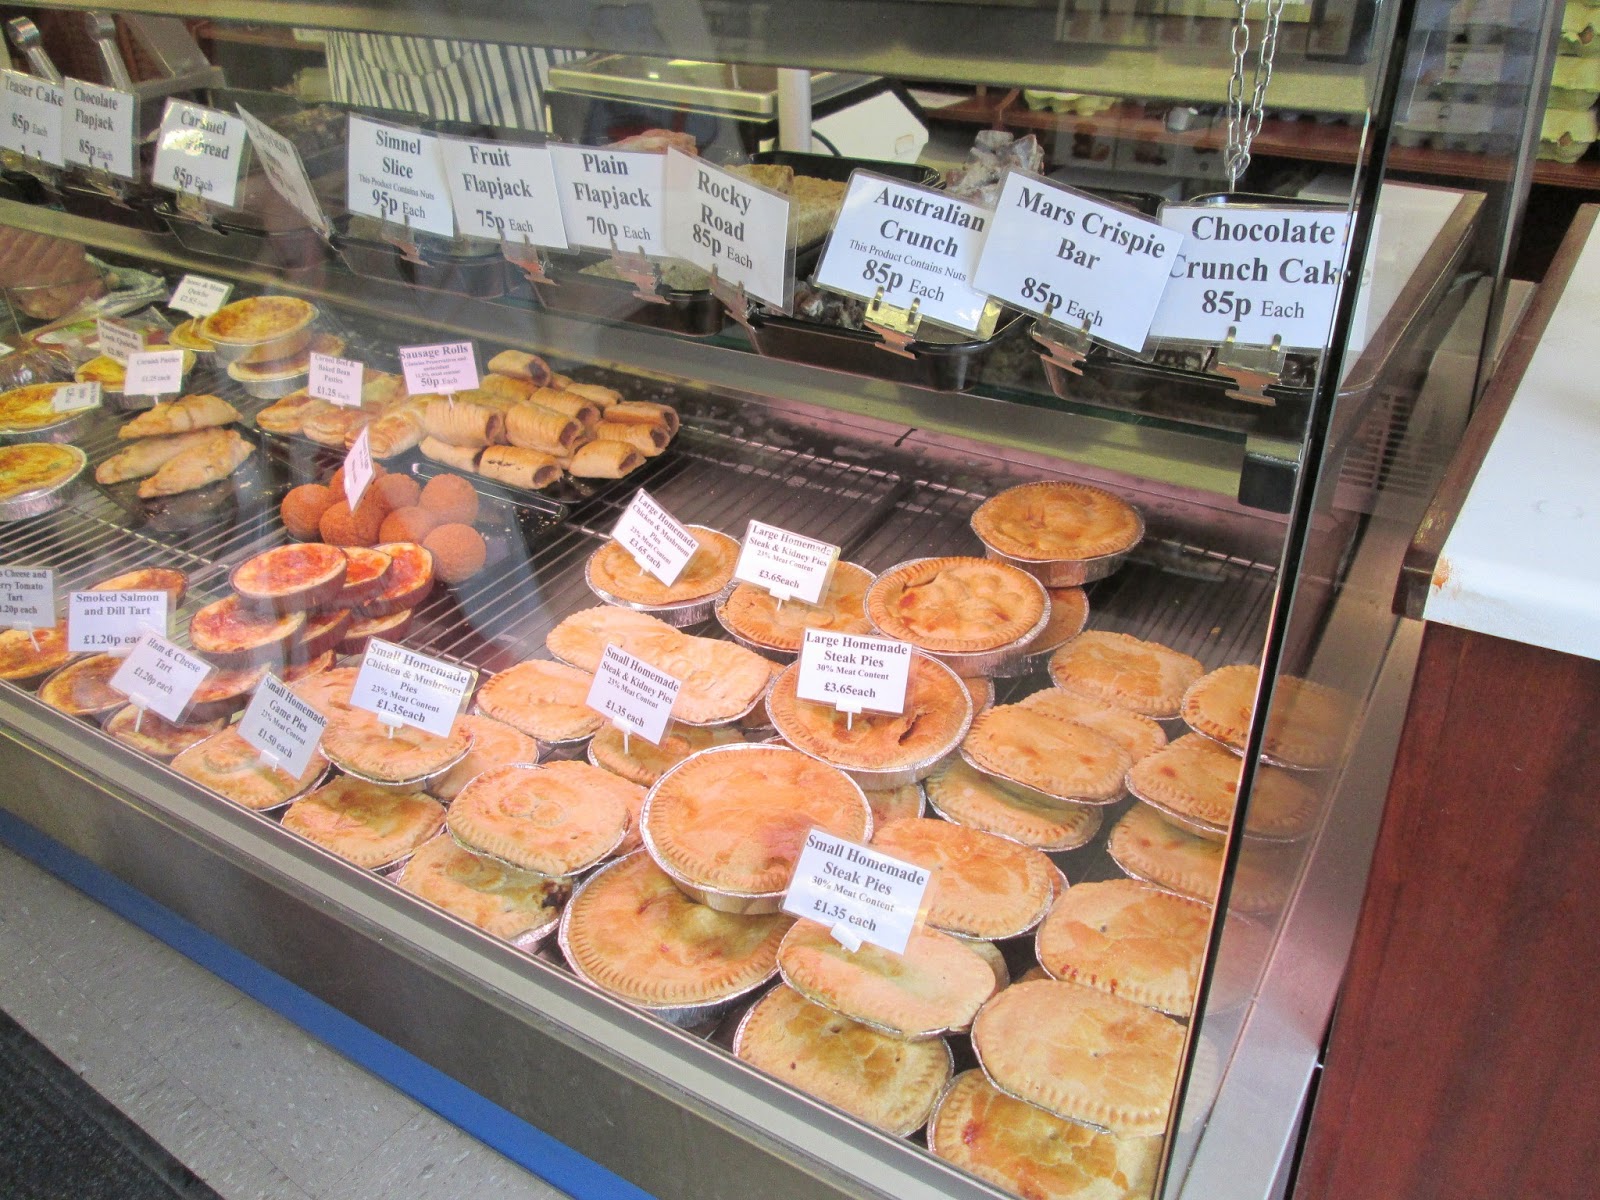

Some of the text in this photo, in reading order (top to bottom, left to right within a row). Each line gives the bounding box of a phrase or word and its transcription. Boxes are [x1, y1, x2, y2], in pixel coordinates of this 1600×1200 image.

[36, 86, 64, 106] Cake
[75, 87, 117, 110] Chocolate
[12, 113, 29, 134] 85p
[76, 108, 113, 131] Flapjack
[79, 139, 95, 158] 85p
[376, 130, 421, 155] Simnel
[469, 146, 512, 167] Fruit
[382, 157, 413, 179] Slice
[582, 153, 629, 175] Plain
[173, 166, 213, 192] 85p Each
[359, 174, 435, 200] This Product Contains Nuts
[463, 173, 534, 200] Flapjack
[698, 170, 751, 216] Rocky
[372, 189, 426, 218] 95p Each
[573, 182, 652, 210] Flapjack
[874, 187, 985, 232] Australian
[476, 210, 534, 233] 75p Each
[586, 216, 651, 241] 70p Each
[701, 204, 745, 242] Road
[1016, 186, 1166, 258] Mars Crispie
[1192, 215, 1336, 244] Chocolate
[693, 224, 752, 269] 85p Each
[880, 219, 959, 257] Crunch
[849, 239, 966, 281] This Product Contains Nuts
[1056, 237, 1101, 270] Bar
[1170, 253, 1268, 282] Crunch
[862, 259, 944, 302] 85p Each
[1021, 277, 1103, 327] 85p Each
[1202, 290, 1304, 322] 85p Each
[400, 345, 468, 359] Sausage Rolls
[318, 386, 336, 397] £1.25
[325, 375, 343, 384] Pasties
[421, 377, 439, 387] 50p
[632, 505, 690, 558] Chicken & Mushroom
[637, 495, 696, 550] Large Homemade
[629, 525, 672, 565] 23% Meat Content
[649, 532, 661, 545] Pies
[748, 537, 827, 568] Steak & Kidney Pies
[752, 525, 831, 556] Large Homemade
[629, 538, 661, 569] £3.65 each
[756, 550, 813, 573] 23% Meat Content
[5, 570, 30, 578] Cheese
[14, 582, 43, 590] Tomato
[758, 569, 800, 589] £3.65each
[7, 593, 22, 601] Tart
[20, 606, 37, 614] each
[76, 593, 159, 602] Smoked Salmon
[84, 606, 151, 616] and Dill Tart
[83, 634, 121, 646] £1.20p
[805, 631, 908, 656] Large Homemade
[147, 637, 201, 673] Ham & Cheese
[155, 657, 172, 674] Tart
[370, 642, 467, 684] Small Homemade
[824, 650, 884, 669] Steak Pies
[133, 667, 173, 694] £1.20p each
[365, 658, 462, 697] Chicken & Mushroom
[601, 661, 673, 704] Steak & Kidney Pies
[605, 647, 679, 692] Small Homemade
[816, 663, 890, 681] 30% Meat Content
[264, 677, 327, 727] Small Homemade
[370, 684, 440, 713] 23% Meat Content
[400, 681, 418, 695] Pies
[608, 677, 659, 708] 23% Meat Content
[823, 681, 877, 699] £3.65each
[269, 700, 308, 733] Game Pies
[376, 698, 426, 723] £1.35each
[606, 699, 645, 727] £1.35 each
[261, 709, 306, 745] 23% Meat Content
[258, 728, 293, 758] £1.50 each
[806, 834, 925, 886] Small Homemade
[823, 861, 892, 896] Steak Pies
[812, 875, 895, 913] 30% Meat Content
[813, 899, 877, 932] £1.35 each
